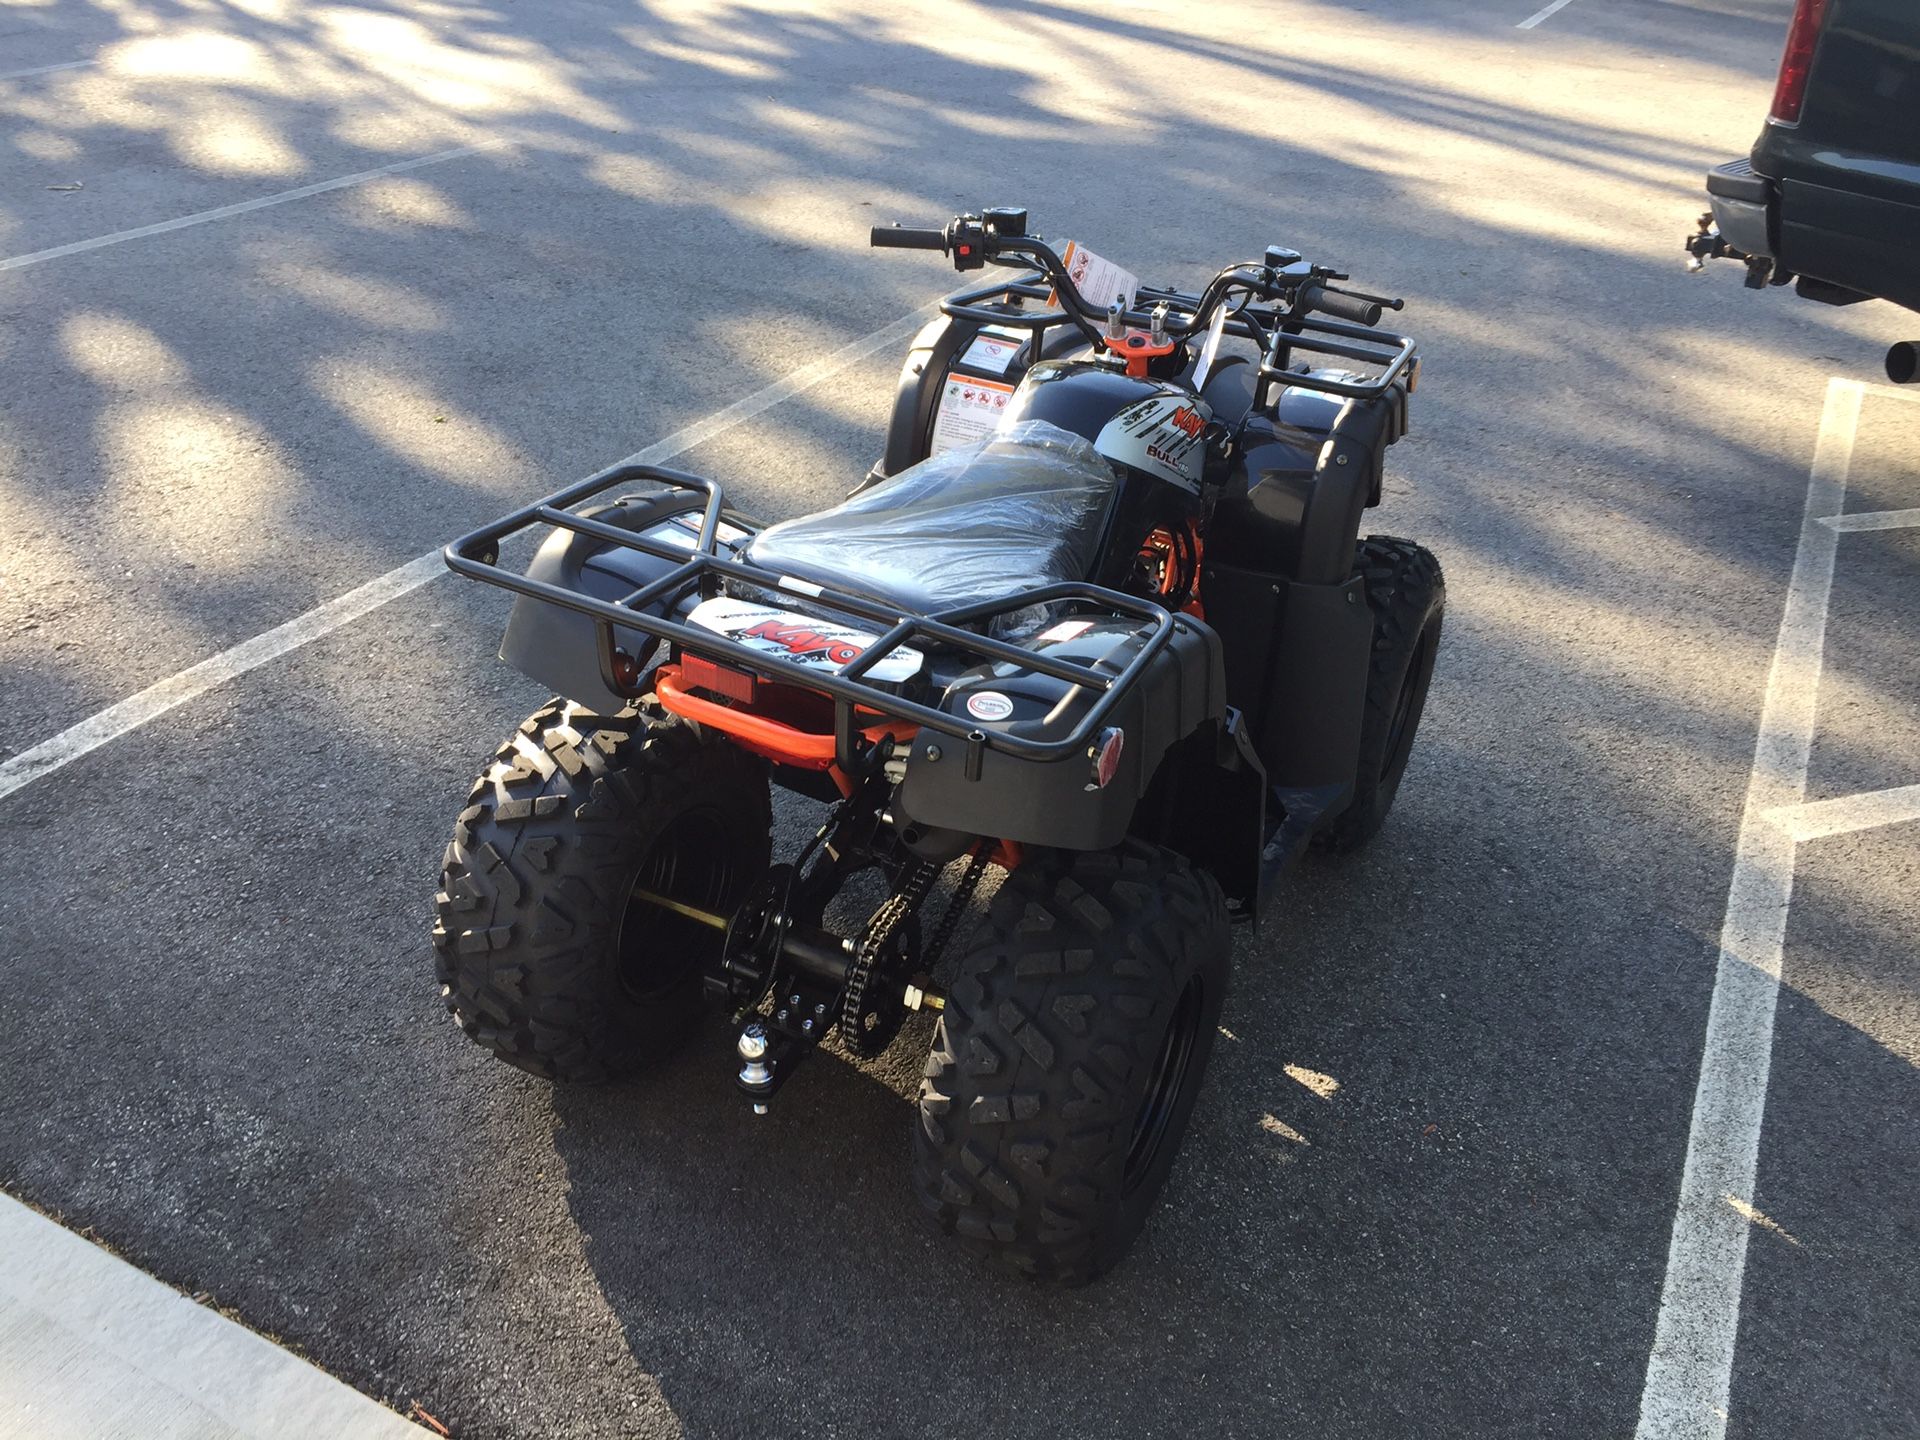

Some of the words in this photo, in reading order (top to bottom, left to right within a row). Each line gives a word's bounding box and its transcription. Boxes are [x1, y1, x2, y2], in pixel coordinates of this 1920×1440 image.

[1172, 404, 1206, 440] KAY
[1146, 444, 1178, 468] BULL
[743, 619, 865, 665] KAYO
